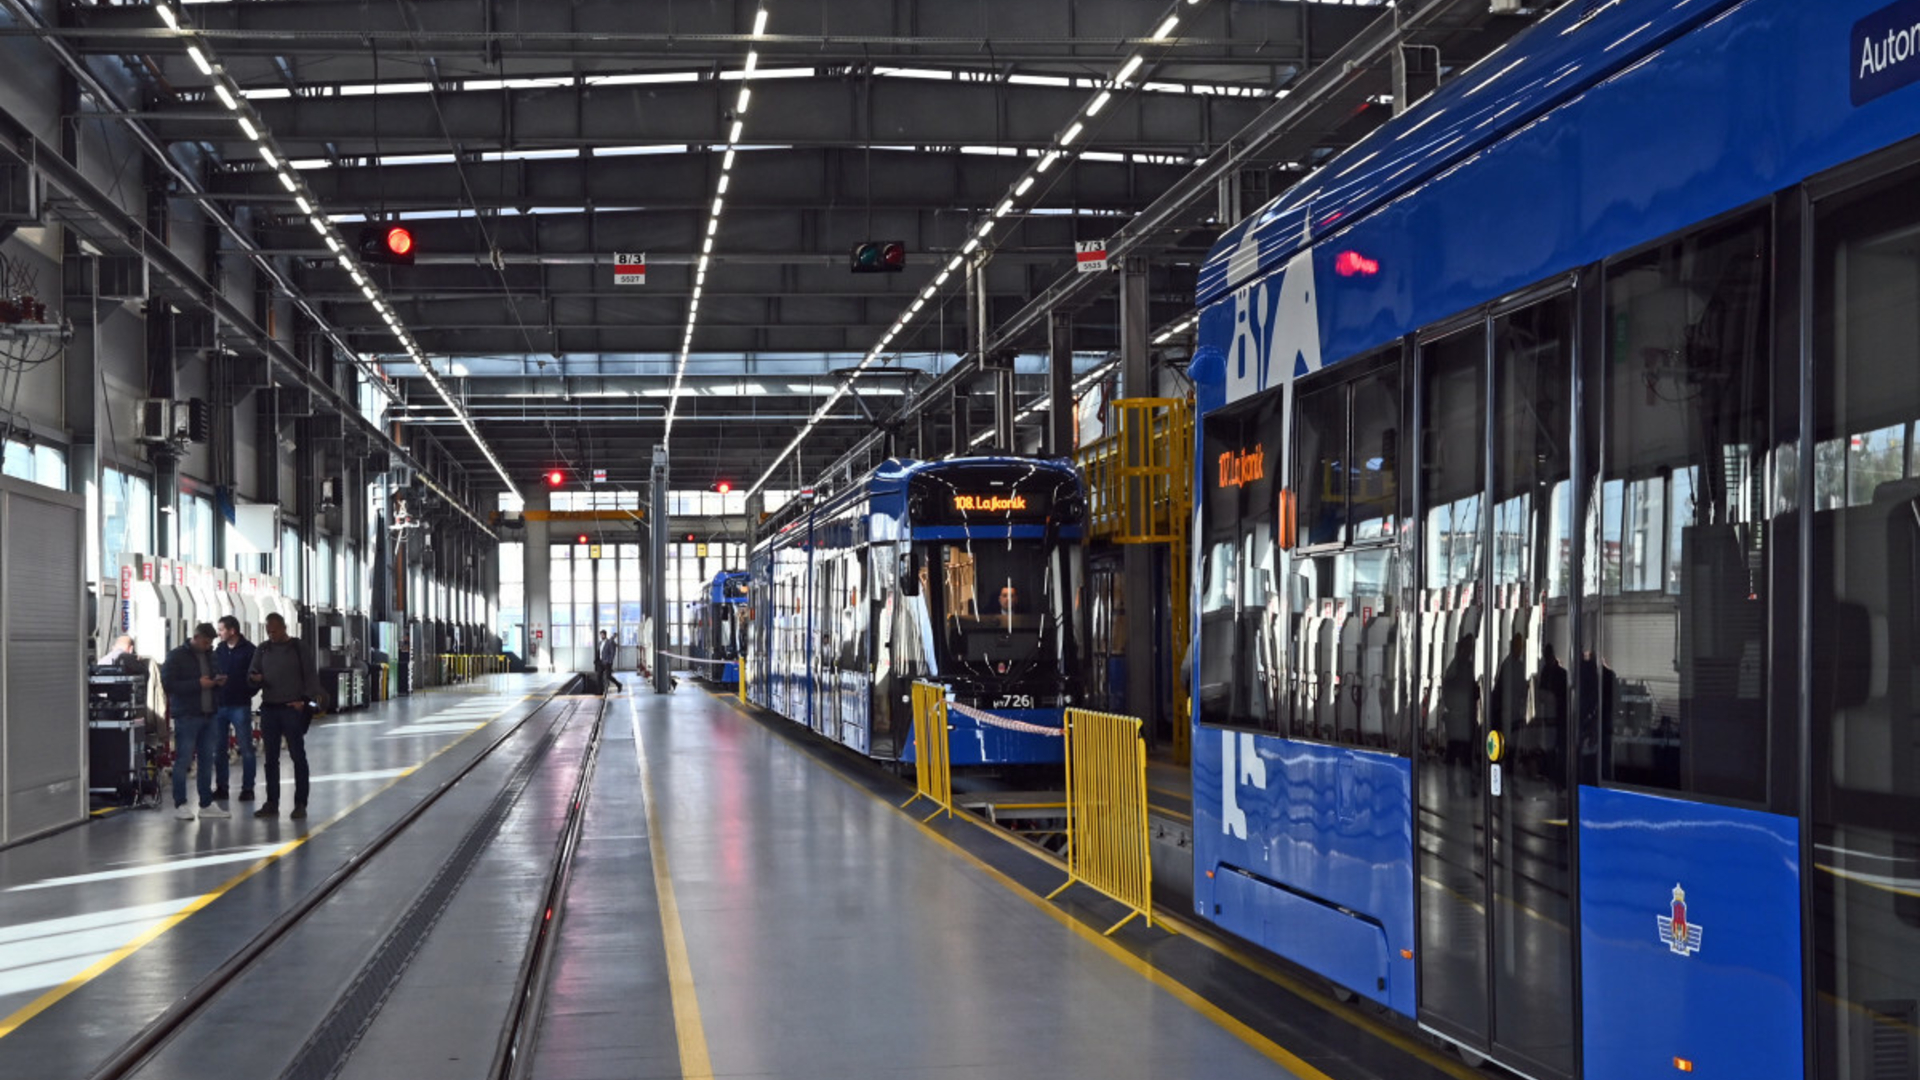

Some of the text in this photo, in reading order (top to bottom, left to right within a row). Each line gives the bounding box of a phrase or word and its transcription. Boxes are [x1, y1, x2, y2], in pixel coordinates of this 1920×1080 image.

[1080, 241, 1103, 251] 7/3
[619, 254, 642, 264] 8/3
[954, 495, 1026, 512] 108. Lajkonik
